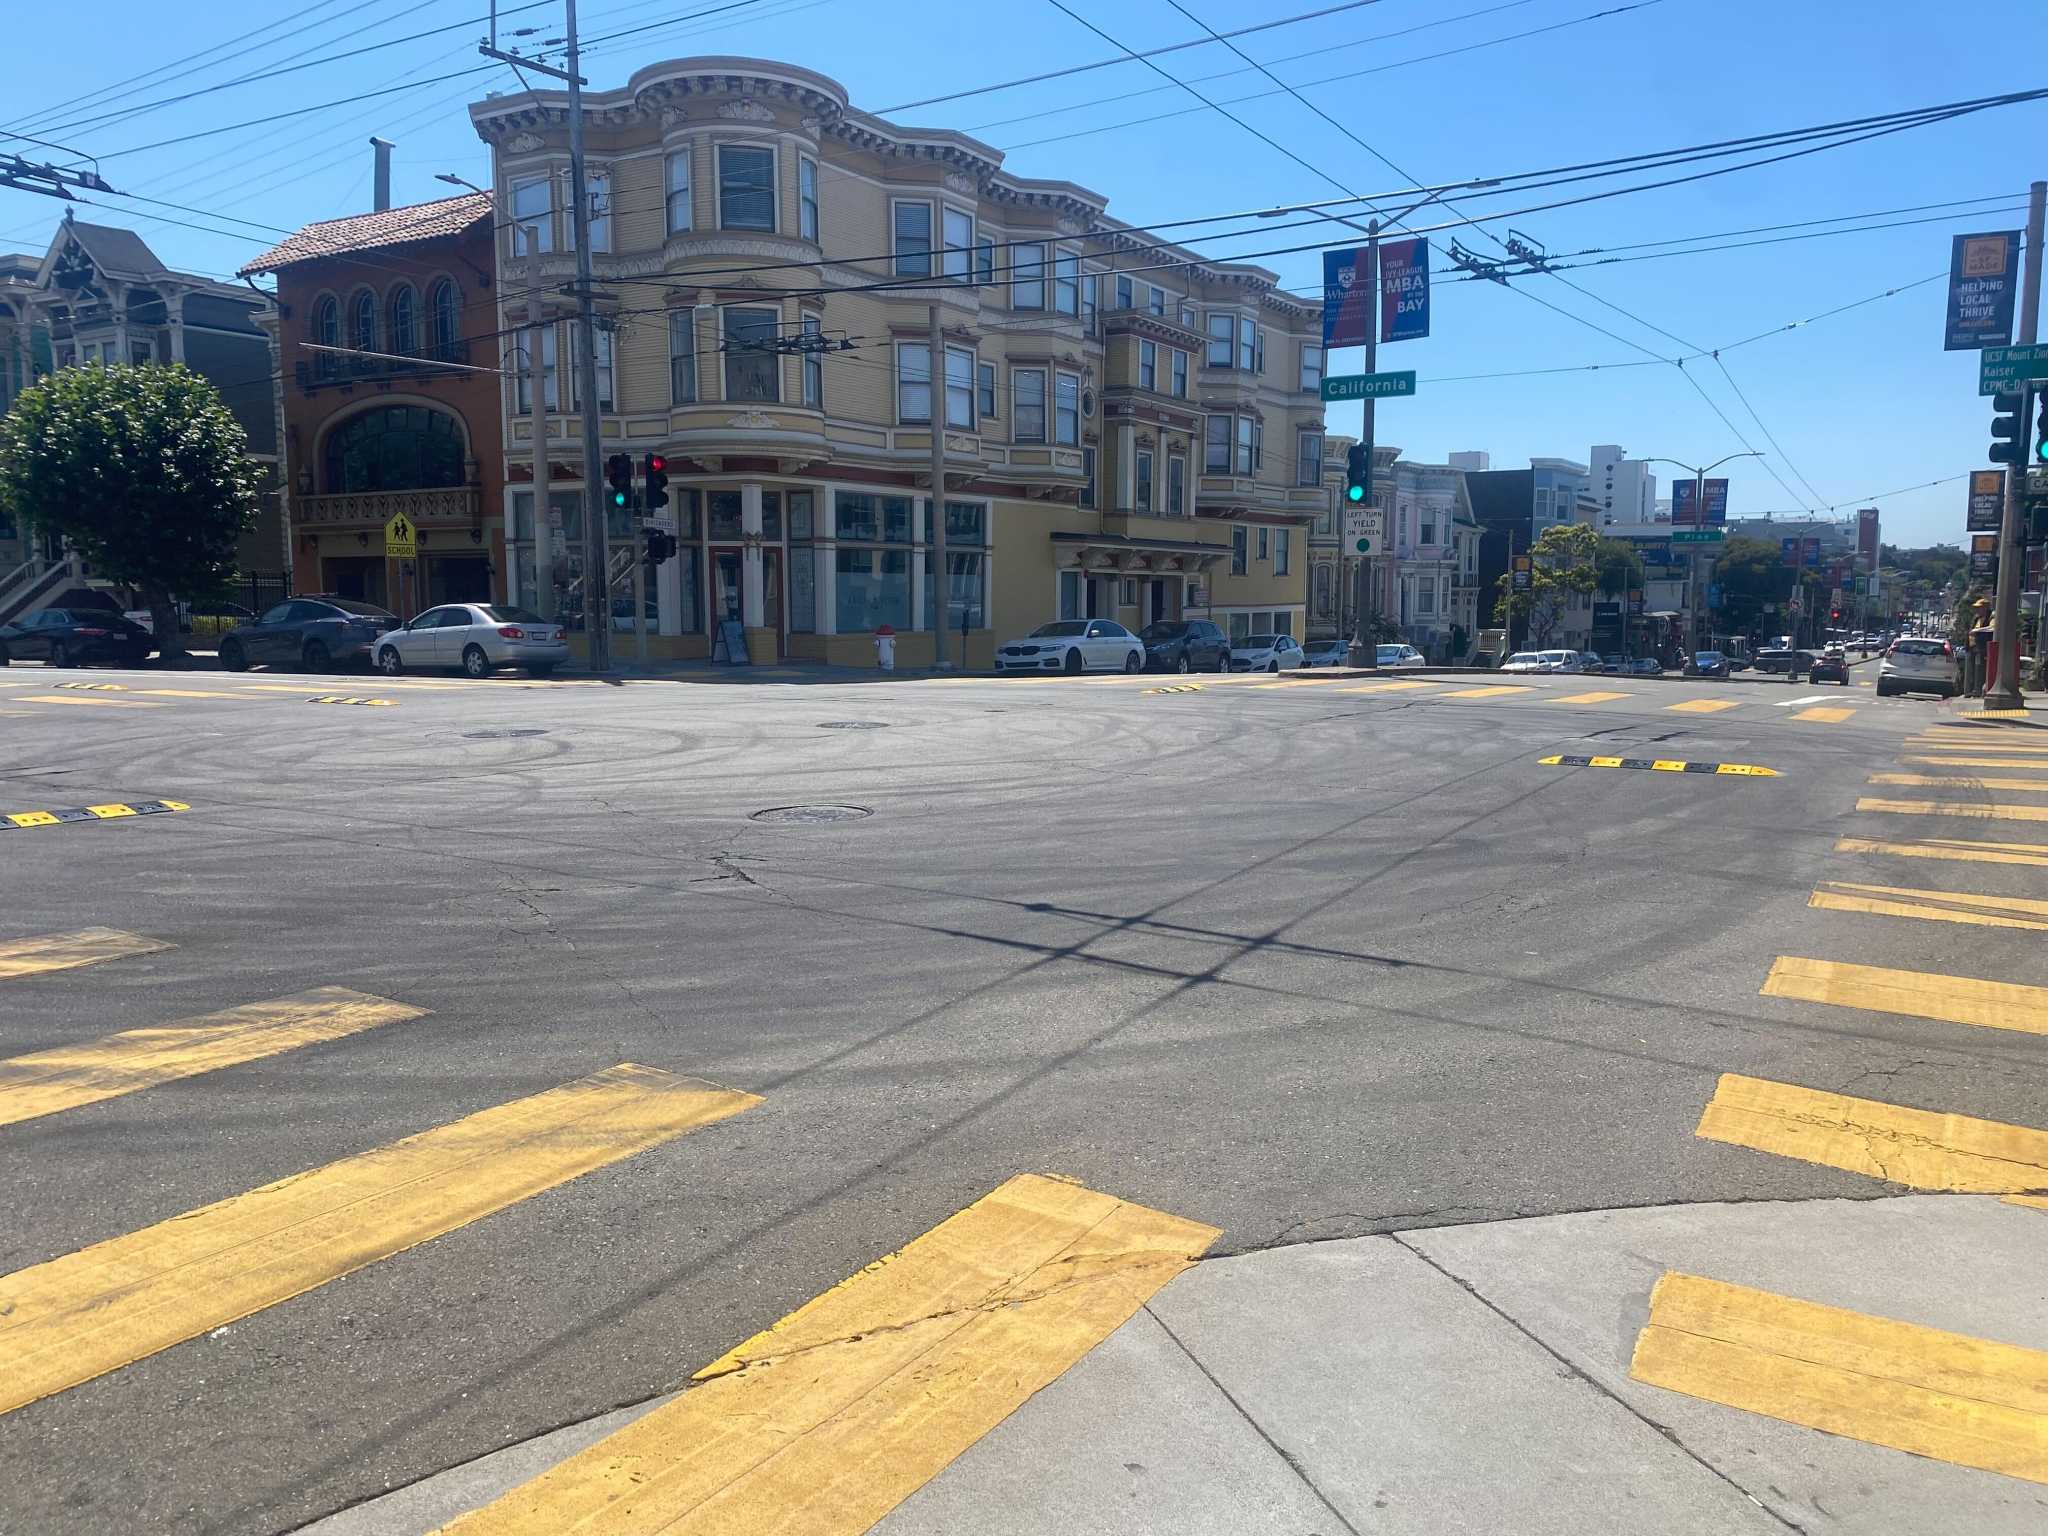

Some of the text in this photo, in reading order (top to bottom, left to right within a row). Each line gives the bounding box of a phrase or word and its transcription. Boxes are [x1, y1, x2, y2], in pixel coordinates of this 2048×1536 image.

[1386, 275, 1424, 293] MBA
[1960, 280, 2004, 293] HELPING
[1326, 289, 1367, 300] Wharton
[1960, 294, 1991, 305] LOCAL
[1397, 298, 1424, 312] BAY
[1959, 305, 1996, 317] THRIVE
[1984, 367, 2016, 376] Kaiser
[1328, 378, 1407, 395] California
[1353, 519, 1376, 527] YIELD
[387, 546, 415, 555] SCHOOL
